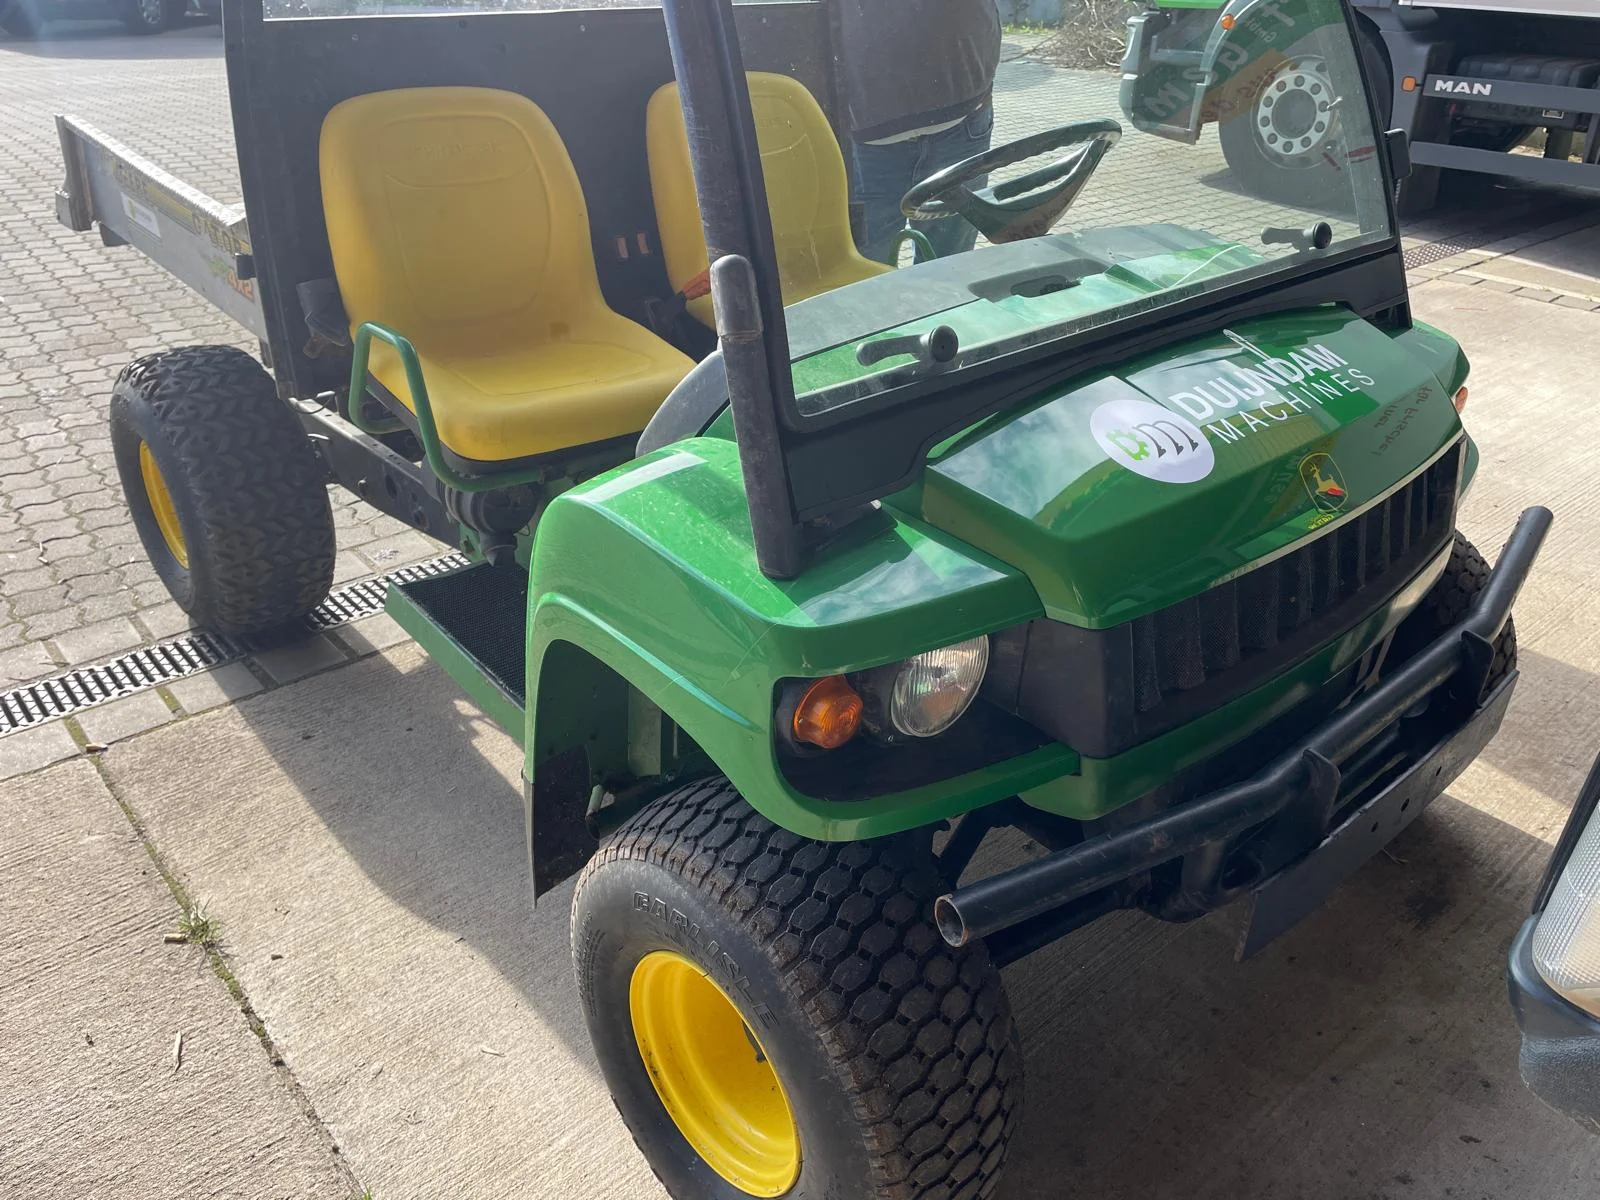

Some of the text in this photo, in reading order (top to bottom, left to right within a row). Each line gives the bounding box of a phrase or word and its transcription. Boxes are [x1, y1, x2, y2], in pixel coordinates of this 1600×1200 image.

[1434, 79, 1492, 96] MAN
[1167, 344, 1349, 420] DUIJNDAM
[1205, 368, 1375, 444] MACHINES
[632, 890, 780, 1030] CARLISLE
